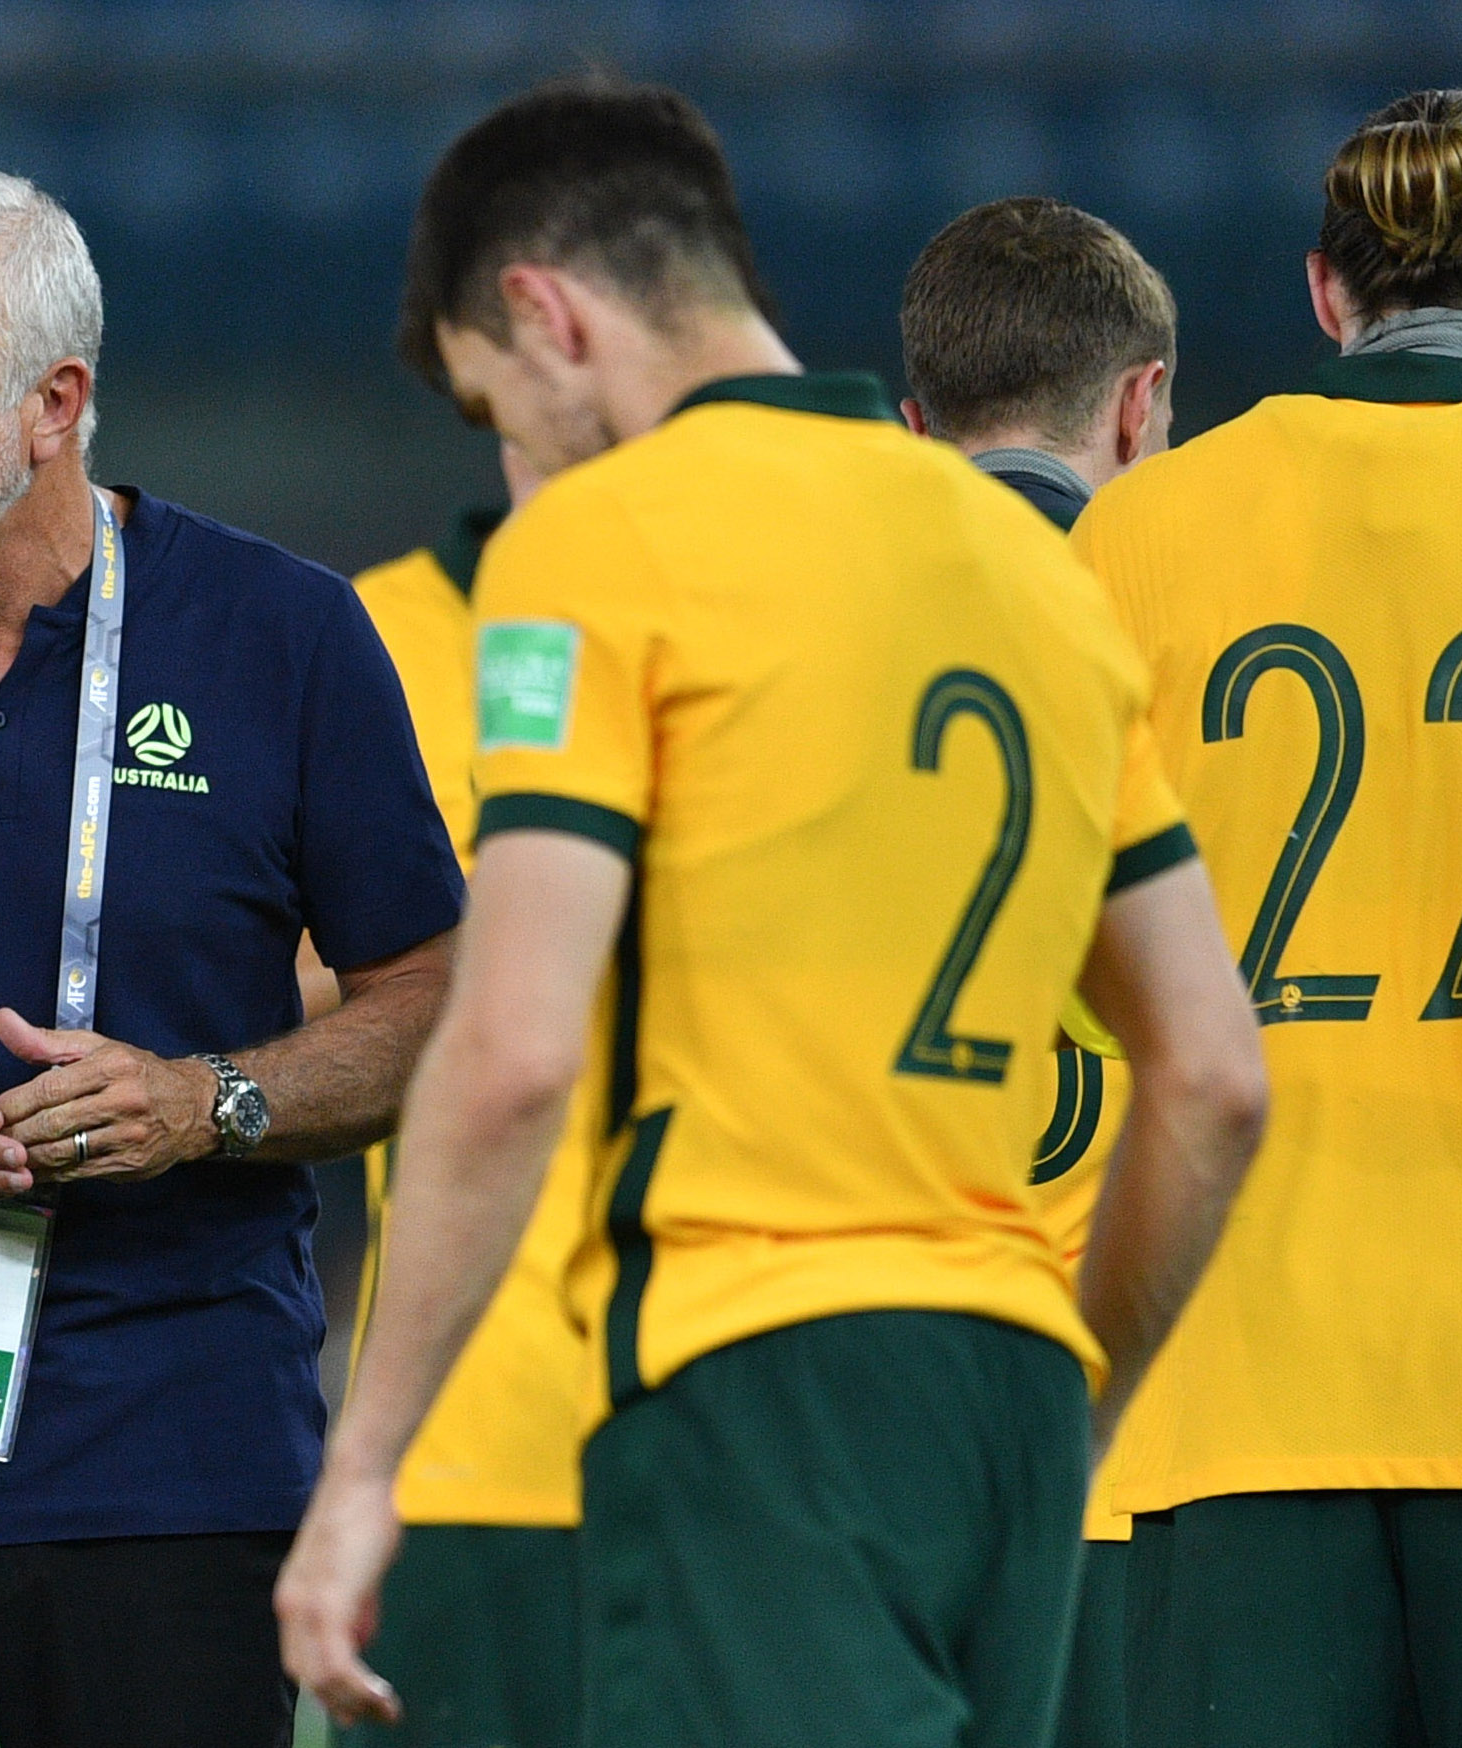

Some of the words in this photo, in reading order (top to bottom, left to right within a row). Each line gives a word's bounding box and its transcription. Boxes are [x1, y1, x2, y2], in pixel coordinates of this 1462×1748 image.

[89, 667, 109, 712] AFC
[113, 767, 210, 794] USTRALIA
[77, 776, 101, 899] the-AFC.com
[1202, 624, 1462, 1027] 2
[893, 670, 1033, 1086] 2
[67, 968, 87, 1014] AFC
